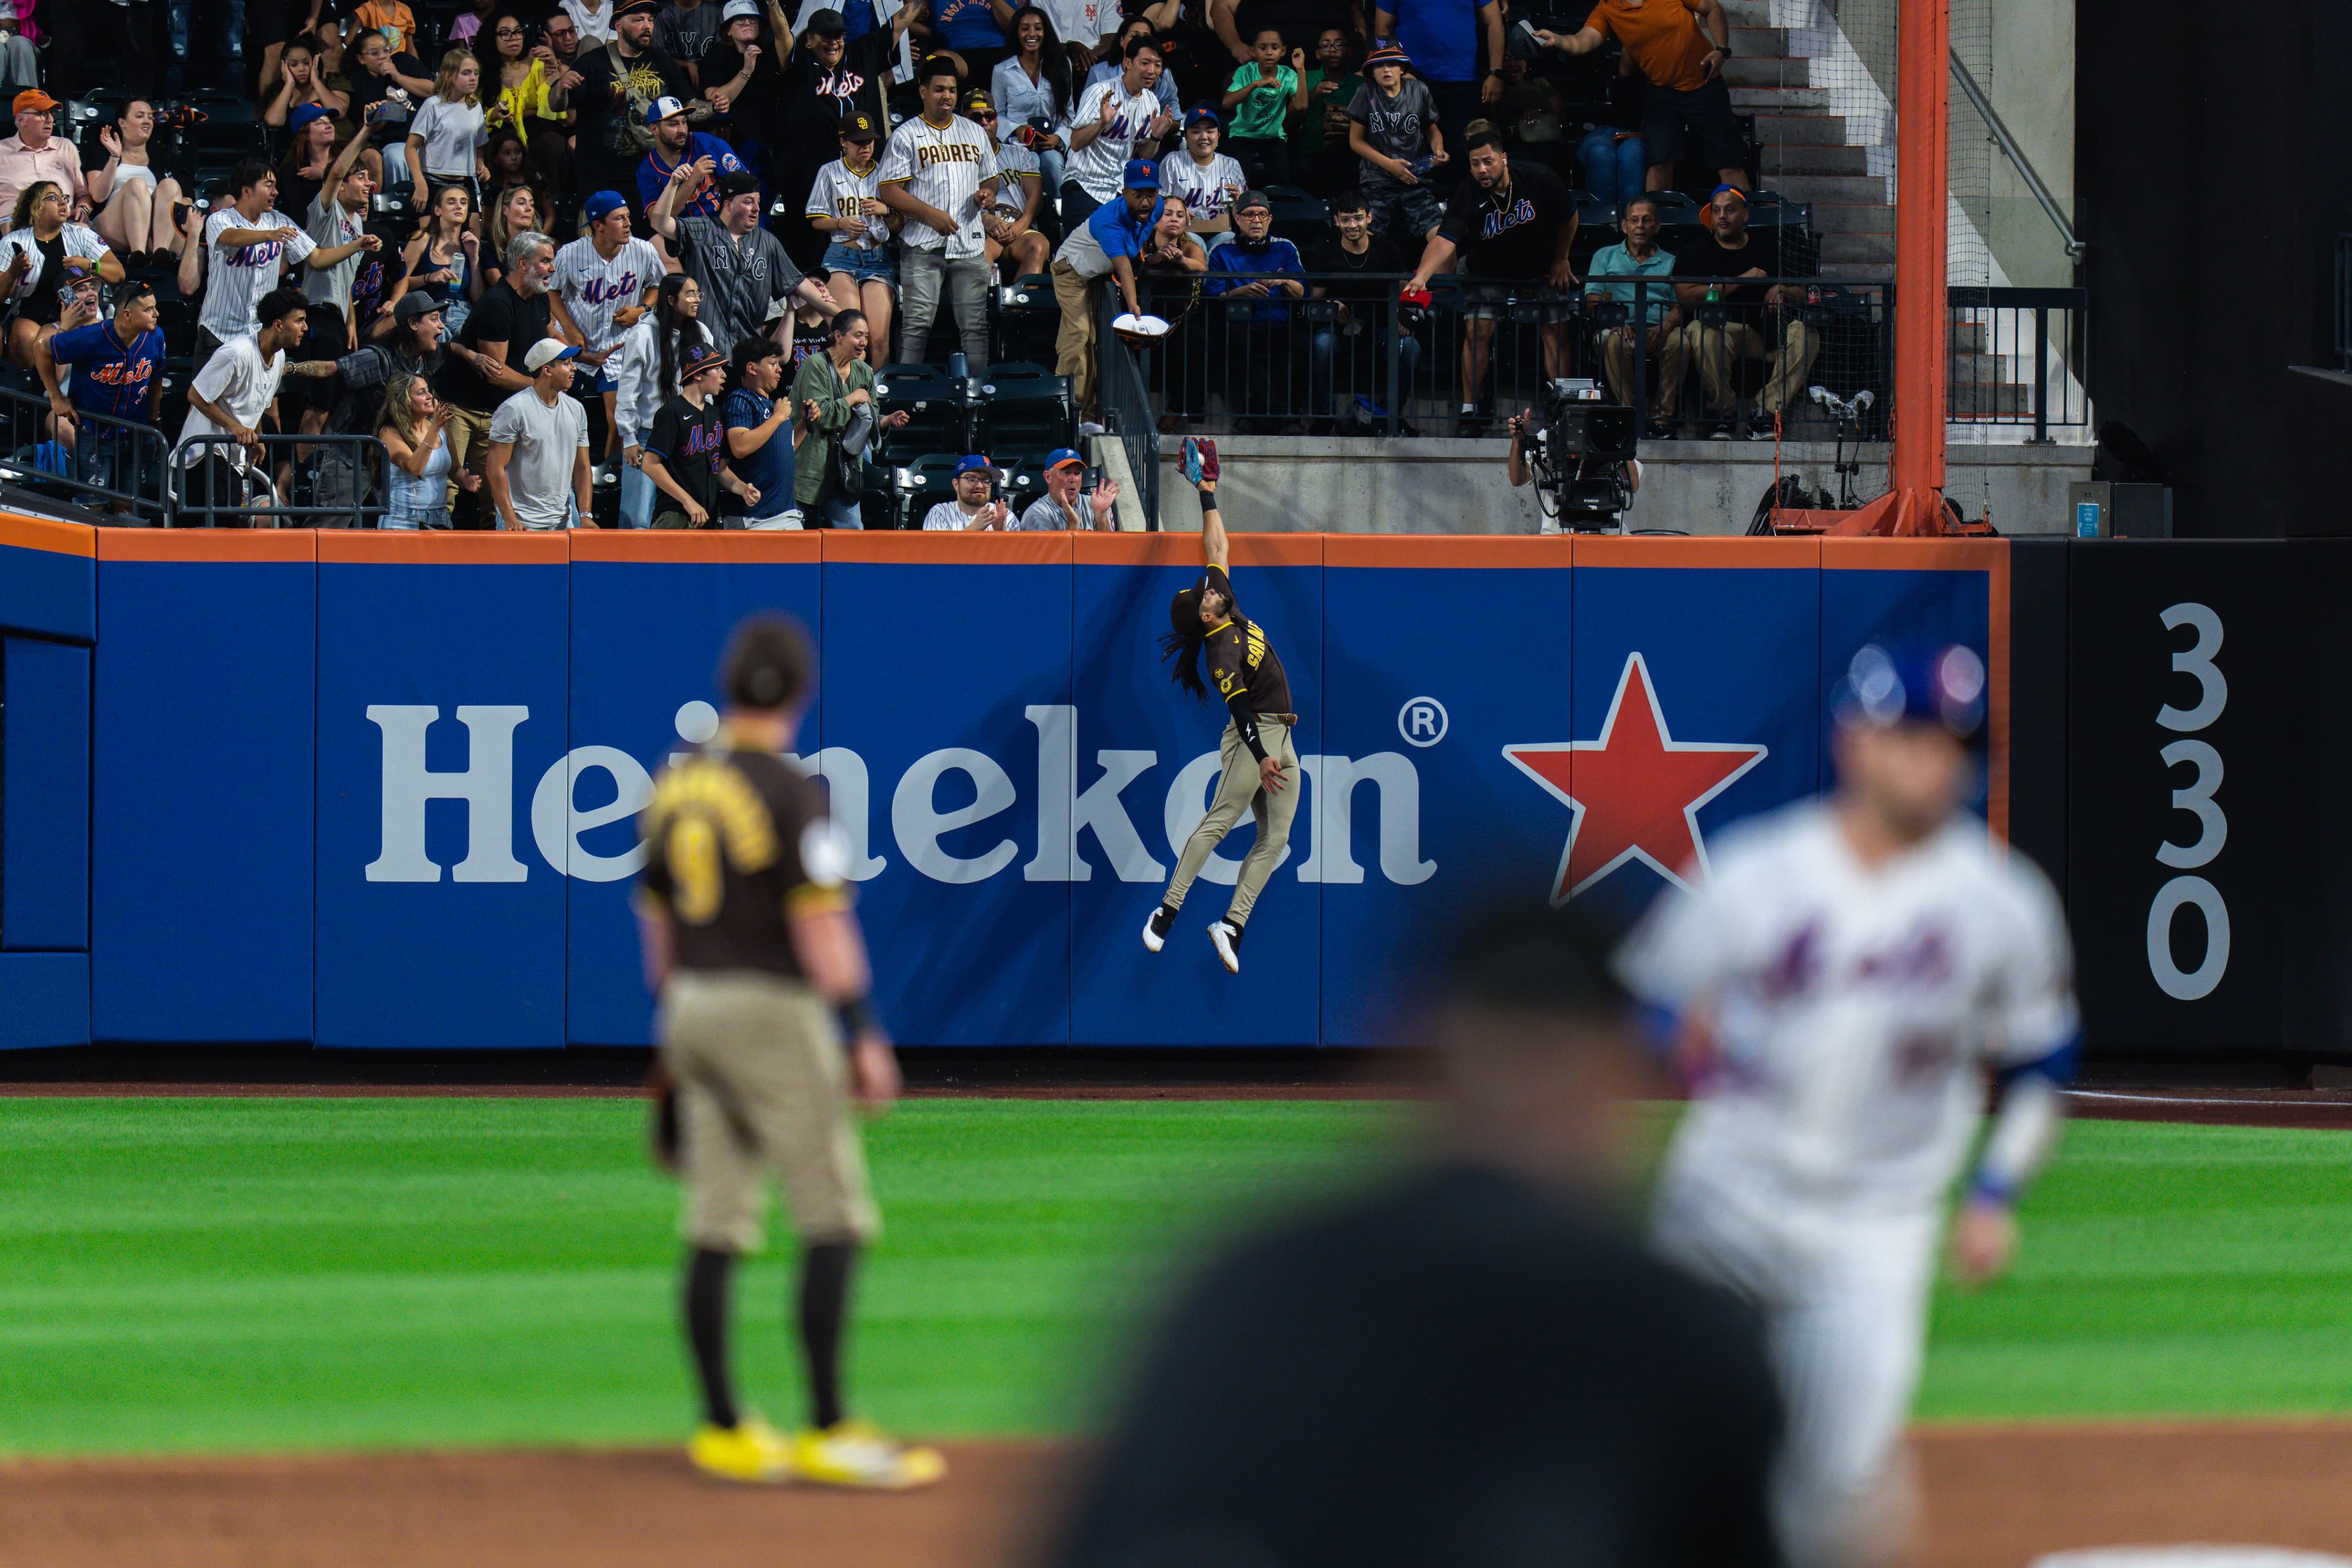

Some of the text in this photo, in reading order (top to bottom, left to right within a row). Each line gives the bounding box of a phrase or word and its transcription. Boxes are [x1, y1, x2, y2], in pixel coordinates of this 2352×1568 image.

[1085, 5, 1096, 21] NY
[815, 70, 865, 98] Mets
[669, 99, 680, 109] NY
[858, 117, 869, 130] SD
[1370, 112, 1418, 134] NYC
[918, 144, 980, 170] PADRES
[1142, 165, 1151, 177] NY
[1479, 198, 1536, 240] Mets
[226, 240, 281, 268] Mets
[712, 245, 767, 281] NYC
[352, 261, 385, 298] ets
[581, 271, 637, 305] Mets
[690, 347, 704, 361] NY
[91, 357, 153, 385] Mets
[680, 420, 725, 456] Met
[1247, 636, 1265, 671] SAN
[2144, 602, 2230, 1001] 330
